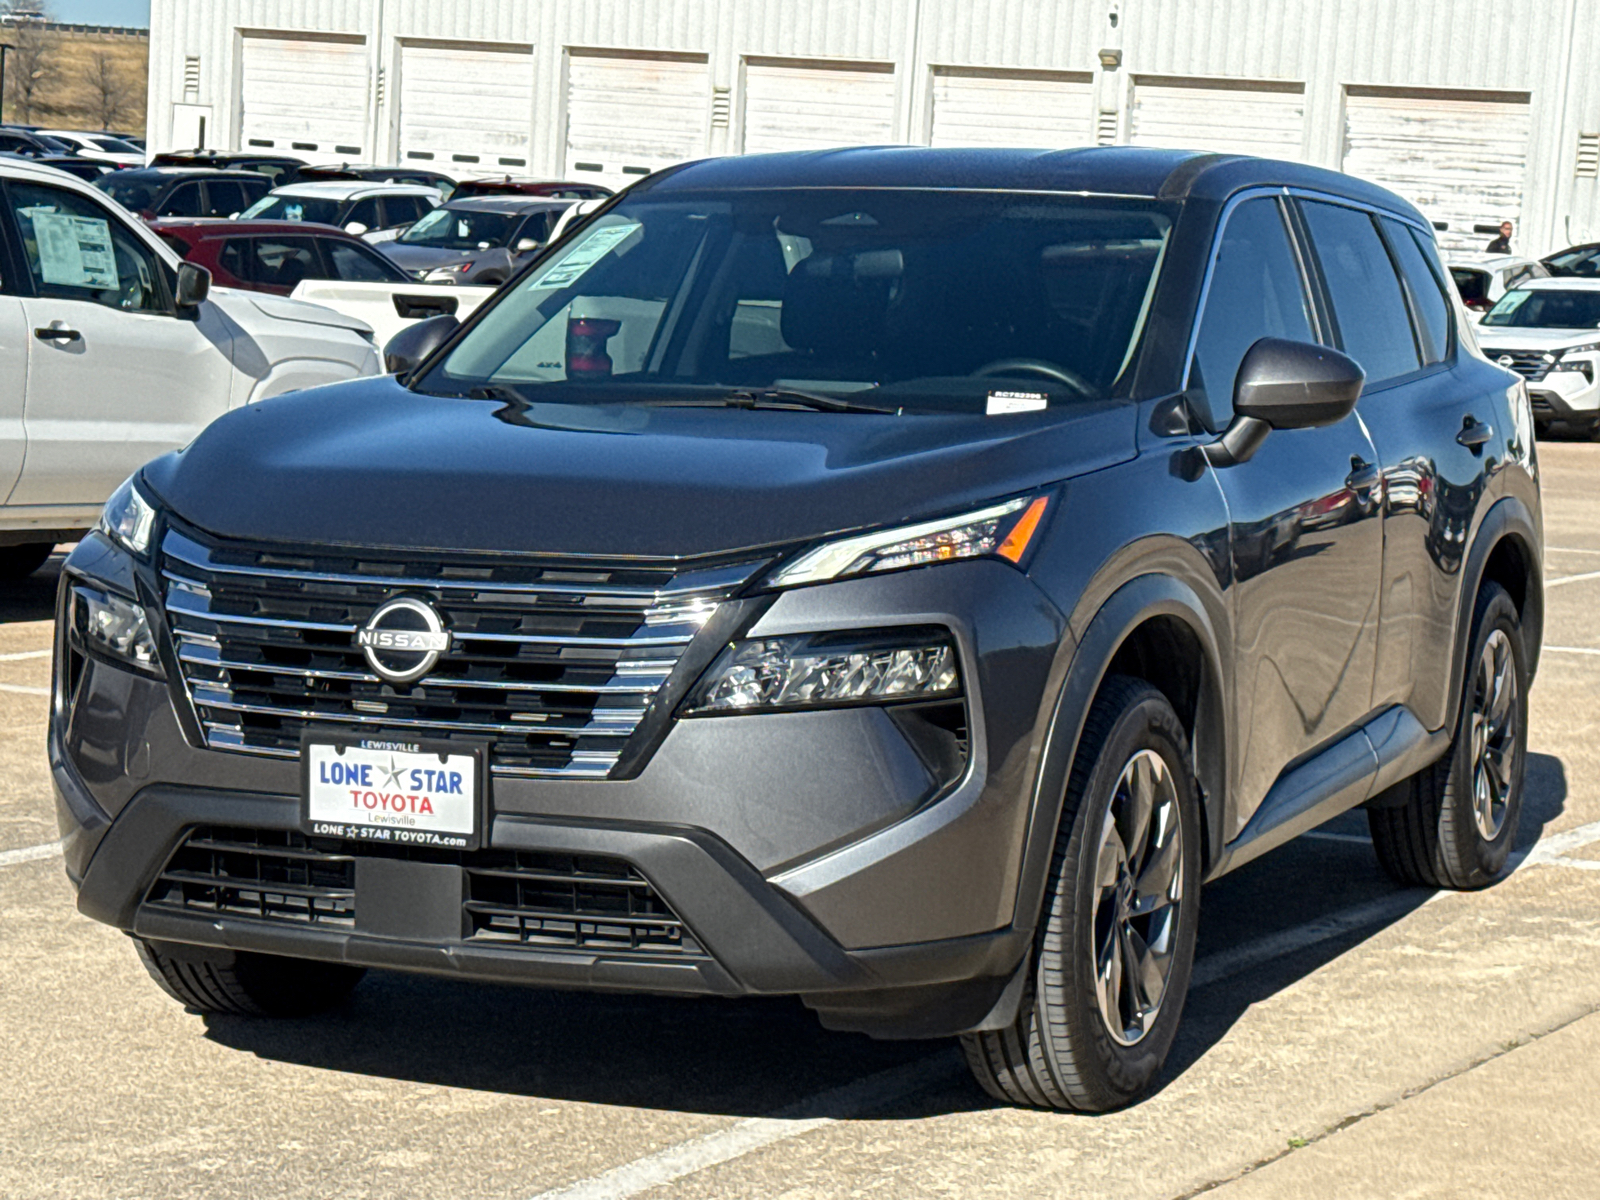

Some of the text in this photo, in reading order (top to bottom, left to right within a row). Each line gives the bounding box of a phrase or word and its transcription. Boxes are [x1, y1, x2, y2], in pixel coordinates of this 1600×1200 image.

[359, 631, 445, 649] NISSAN
[361, 740, 420, 752] LEWISVILLE
[320, 761, 463, 795] LONE STAR
[350, 790, 434, 814] TOYOTA
[368, 812, 416, 826] Lewisville
[314, 823, 467, 846] LONE STAR TOYOTA.com
